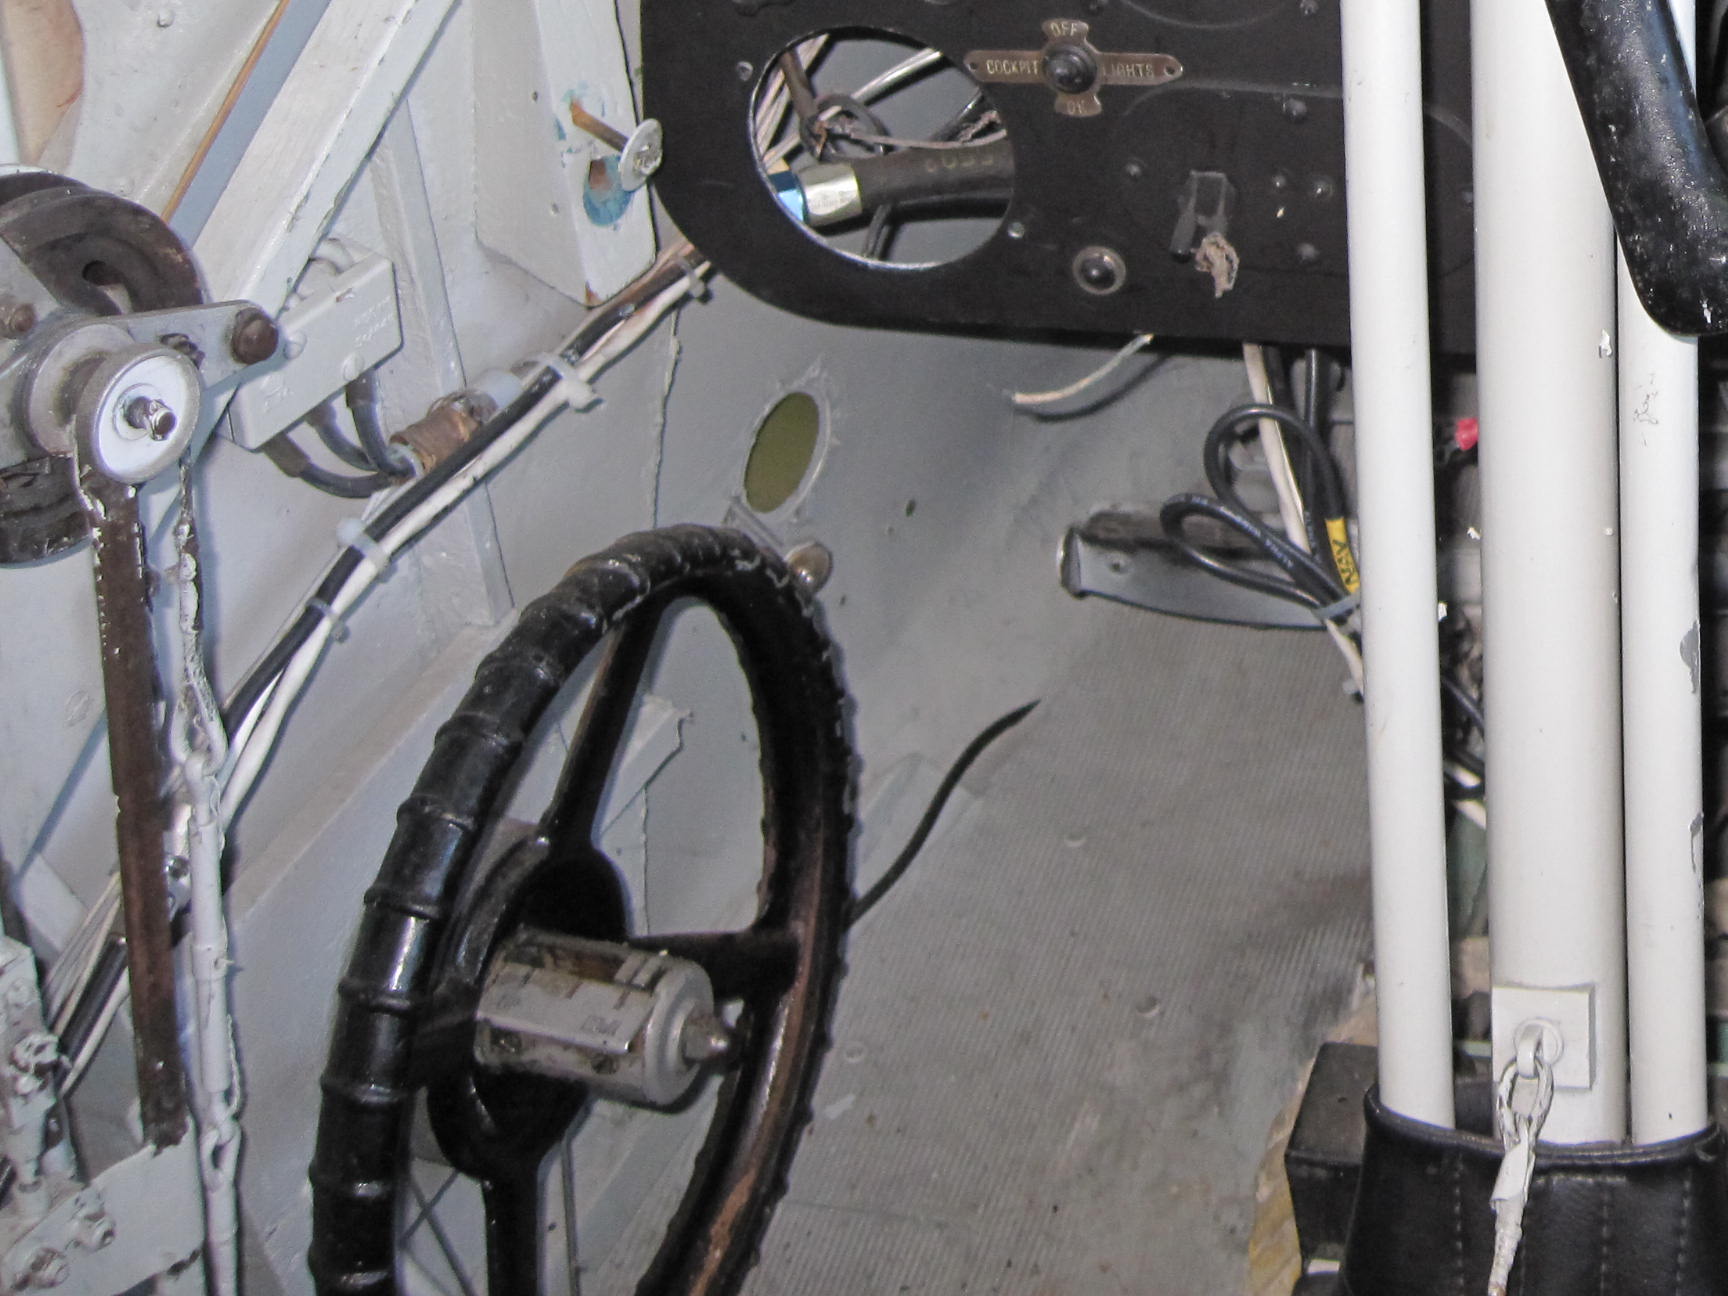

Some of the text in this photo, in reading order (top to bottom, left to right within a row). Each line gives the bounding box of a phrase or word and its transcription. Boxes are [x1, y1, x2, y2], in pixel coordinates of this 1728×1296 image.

[1049, 23, 1078, 37] OFF
[986, 60, 1154, 78] COCKPIT LIGHTS
